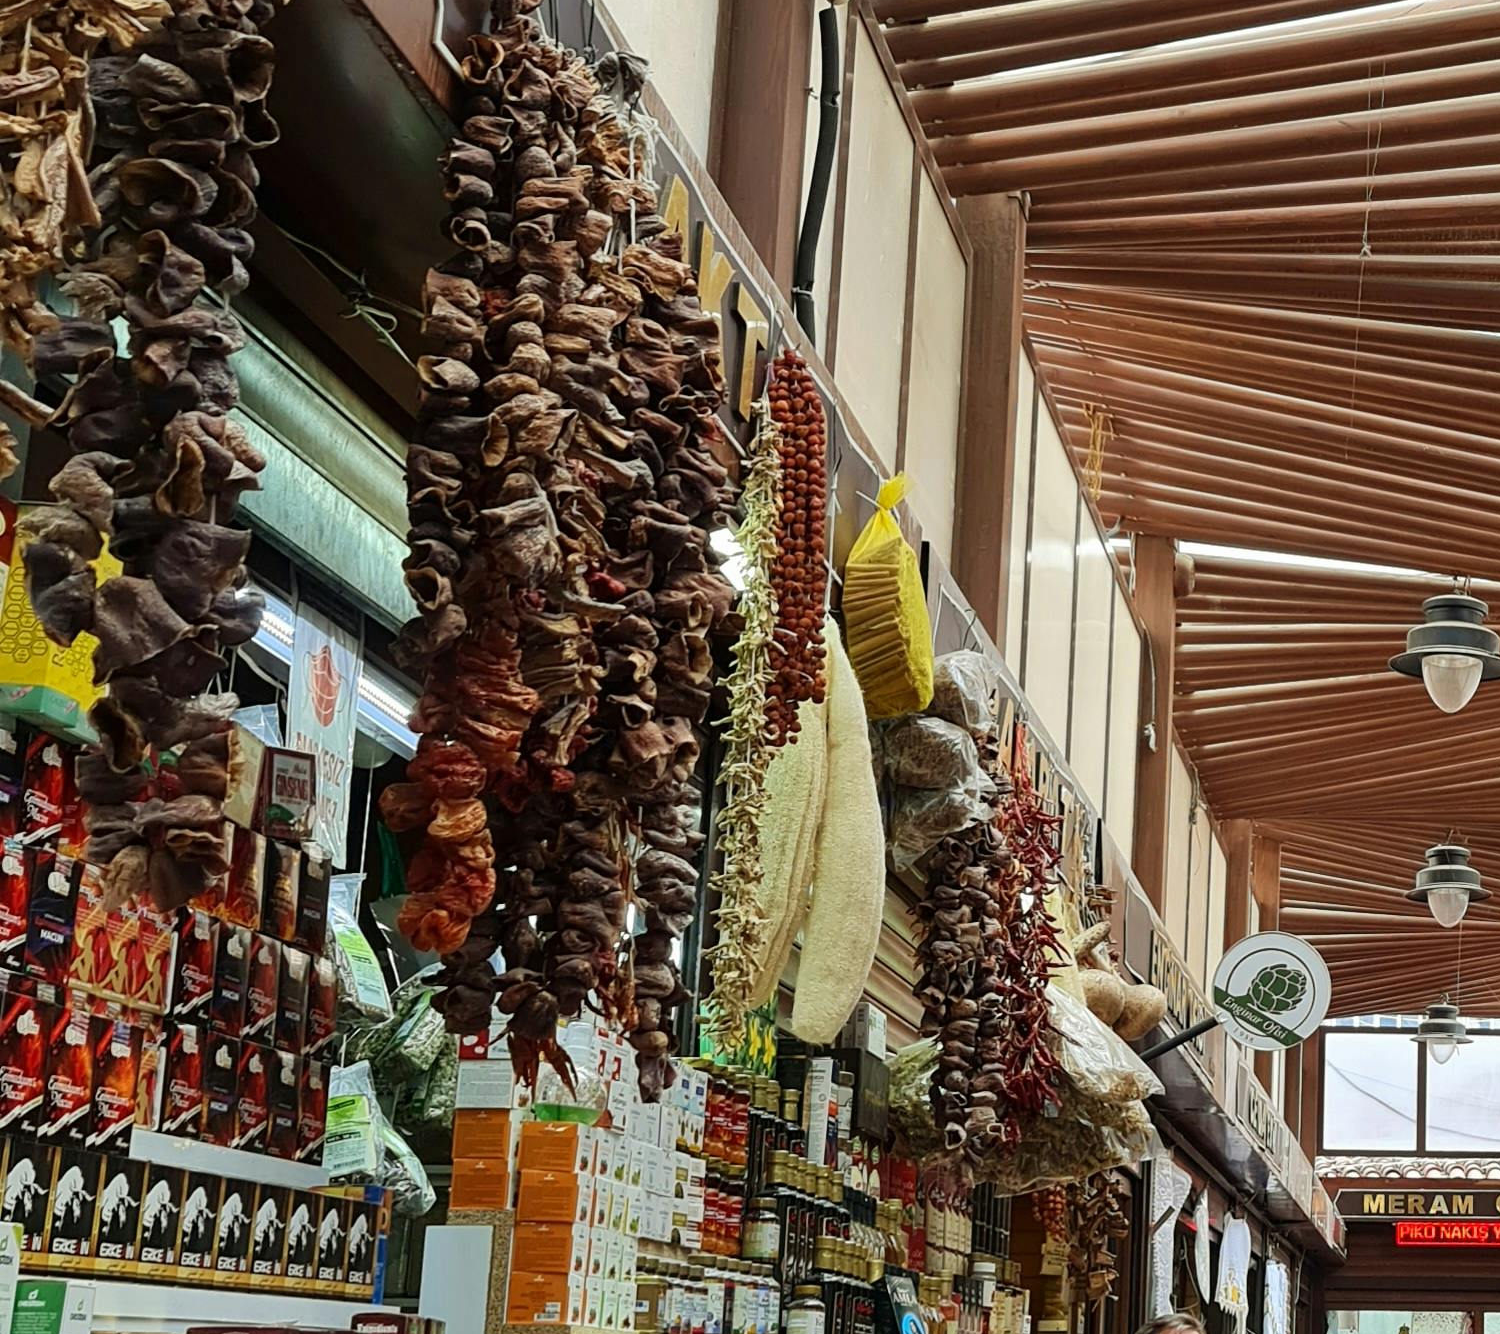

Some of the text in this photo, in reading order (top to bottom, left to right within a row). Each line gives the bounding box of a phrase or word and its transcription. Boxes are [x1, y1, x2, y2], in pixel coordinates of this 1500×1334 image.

[1222, 996, 1288, 1040] Enginar Ofisi
[1363, 1193, 1475, 1215] MERAM
[1440, 1225, 1489, 1243] NAKIŞ
